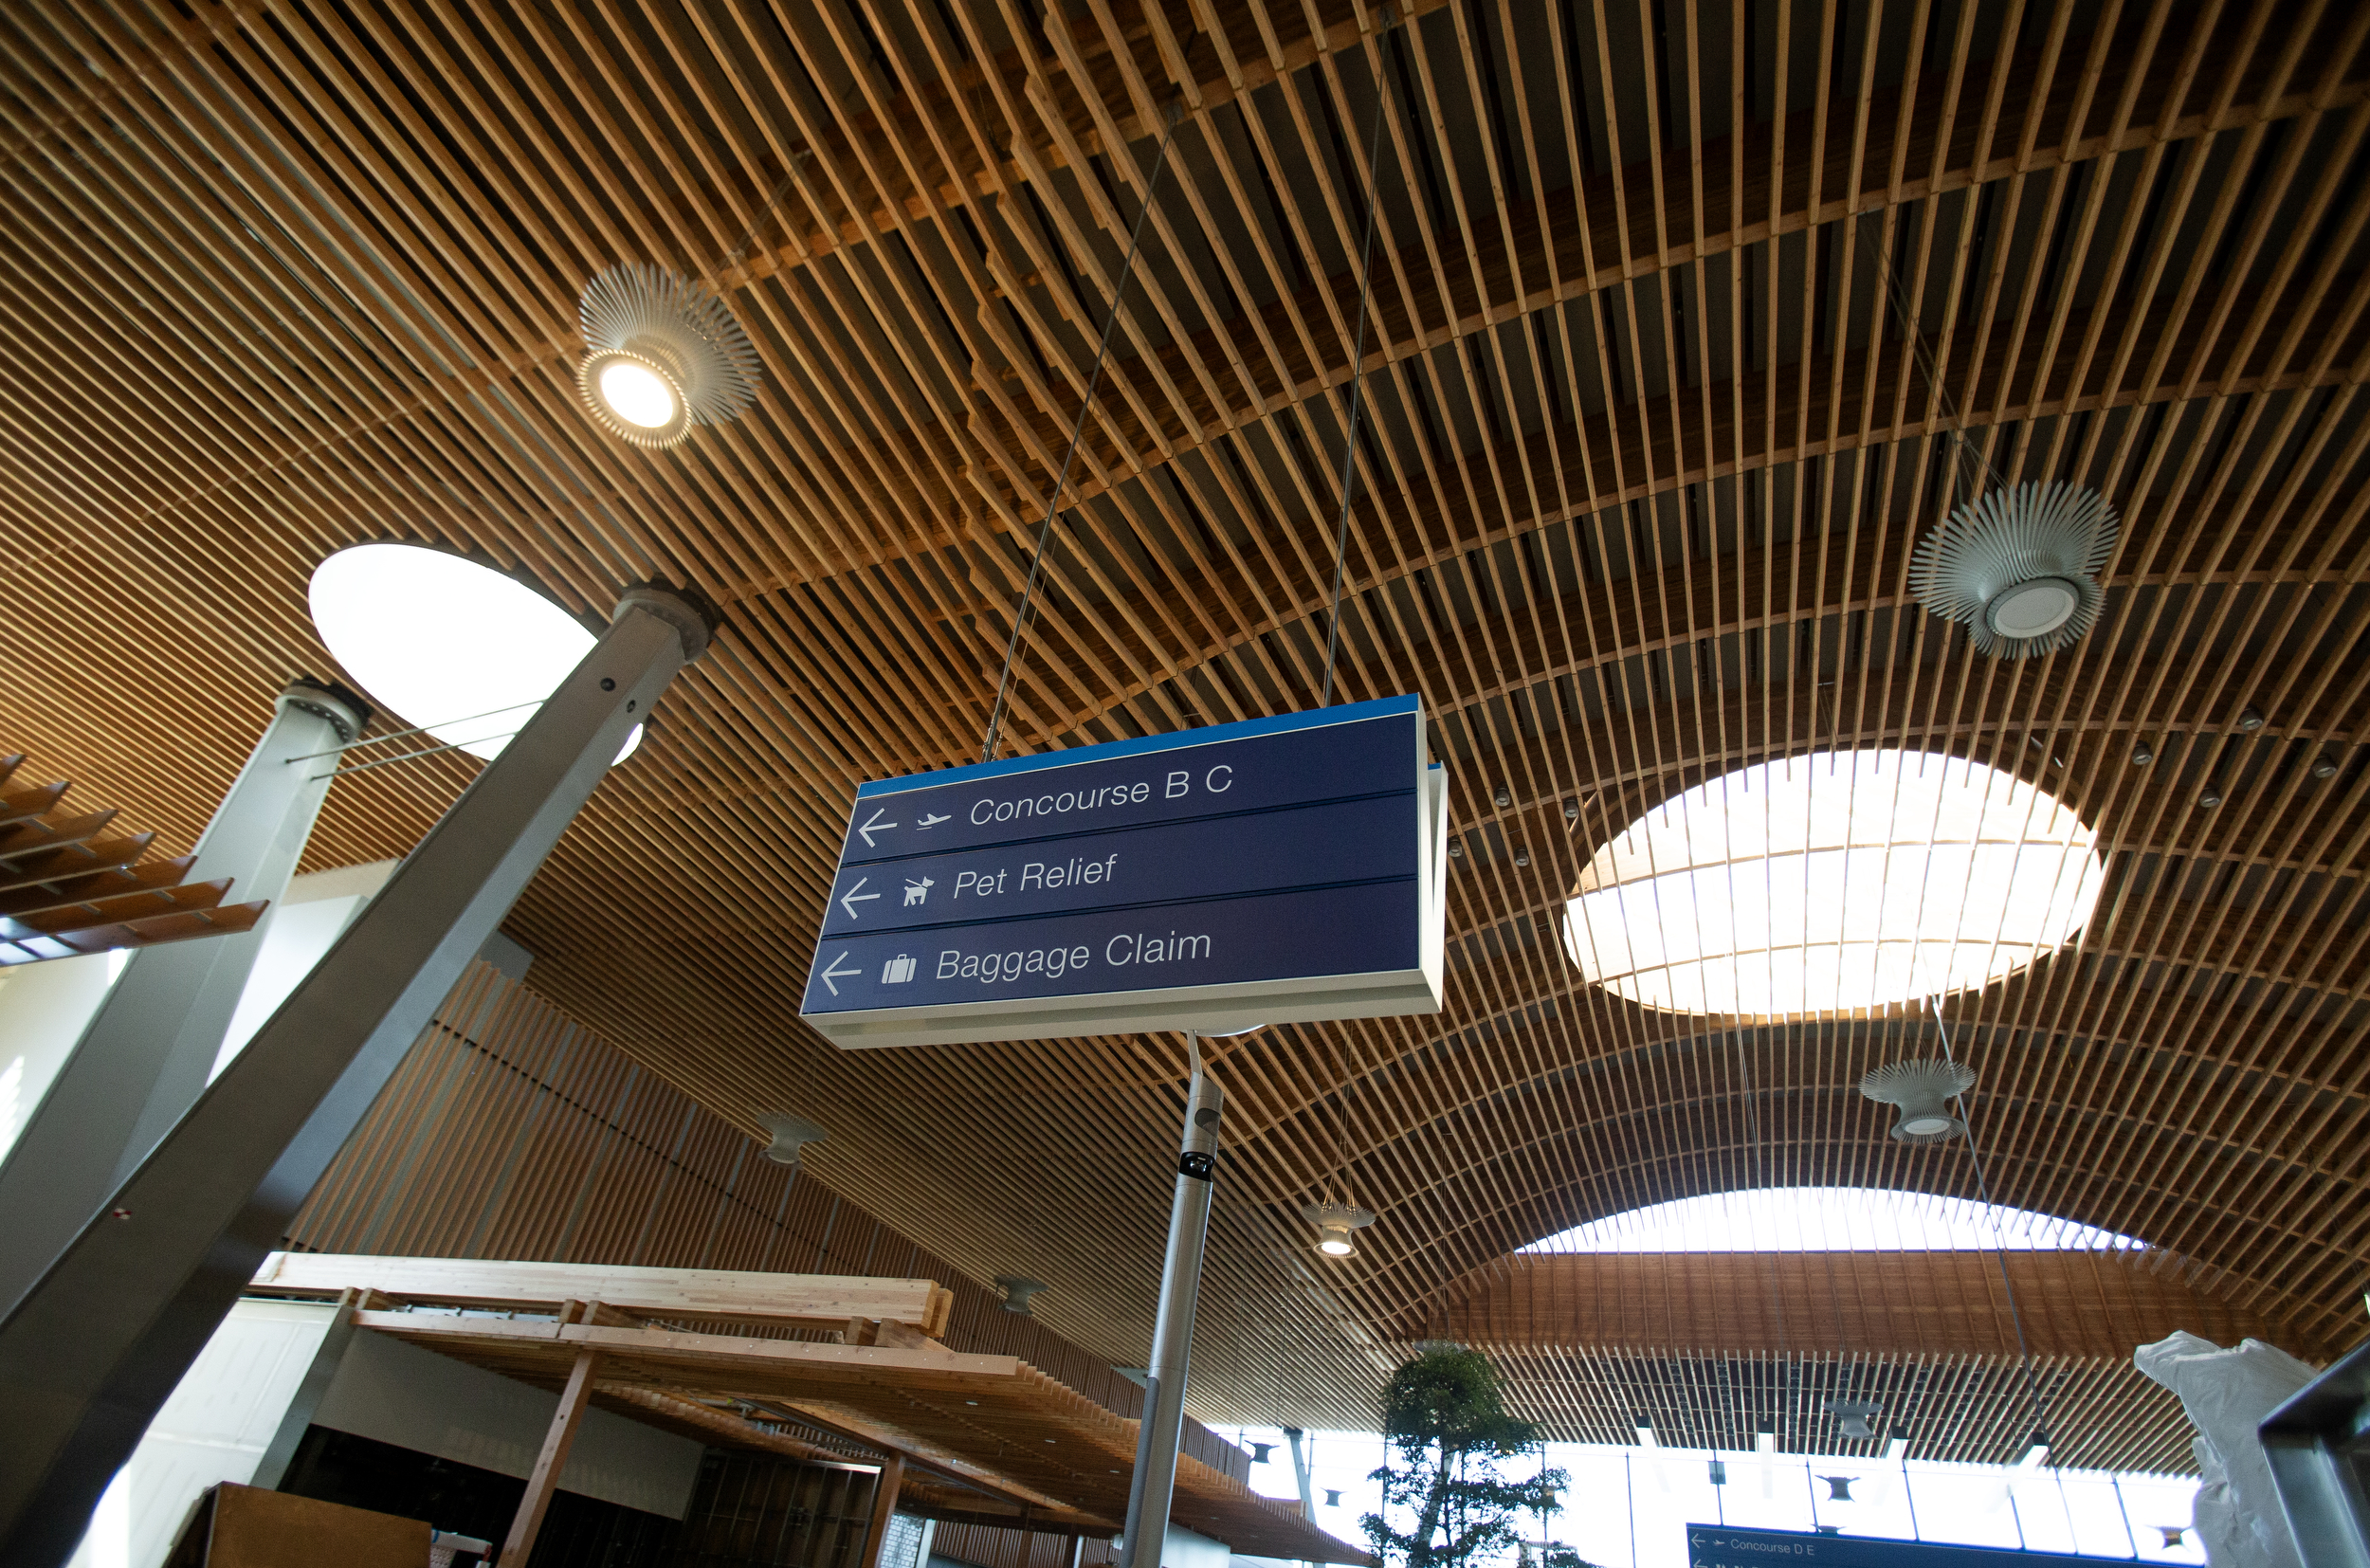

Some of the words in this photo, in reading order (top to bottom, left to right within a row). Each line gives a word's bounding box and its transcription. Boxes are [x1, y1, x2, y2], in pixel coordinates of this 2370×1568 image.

[970, 782, 1150, 826] Concourse
[1165, 771, 1190, 799] B
[1206, 764, 1233, 793] C
[953, 868, 1008, 900] Pet
[1019, 853, 1119, 891] Relief
[936, 945, 1090, 984] Baggage
[1105, 930, 1211, 966] Claim
[1730, 1539, 1791, 1554] Concourse
[1794, 1543, 1803, 1555] D
[1806, 1544, 1814, 1556] E
